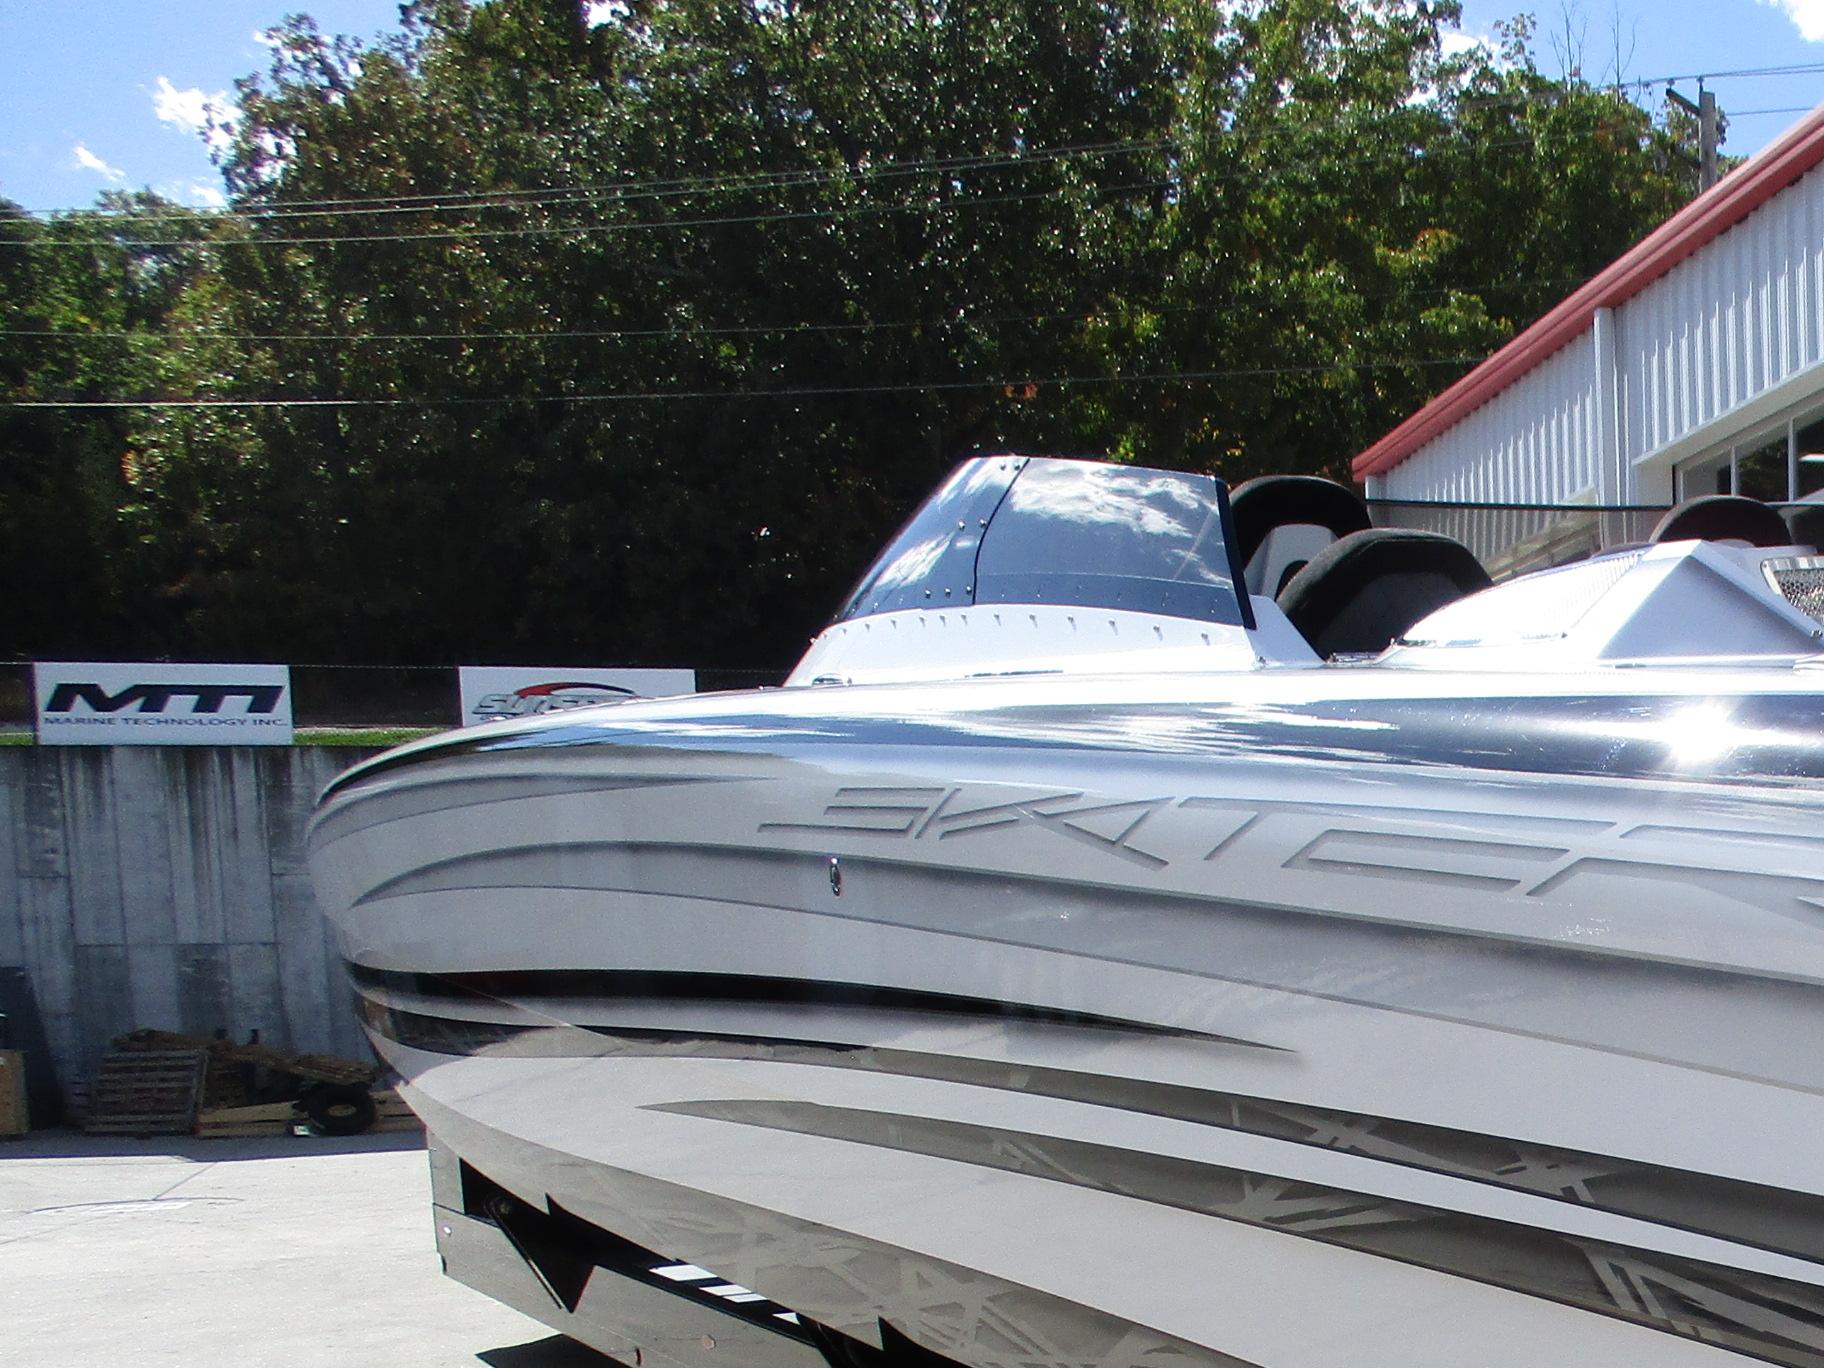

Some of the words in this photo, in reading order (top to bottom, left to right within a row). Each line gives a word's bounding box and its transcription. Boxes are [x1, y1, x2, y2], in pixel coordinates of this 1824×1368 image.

[45, 683, 285, 714] MTI
[44, 716, 116, 726] MARINE
[123, 717, 247, 727] TECHNOLOGY
